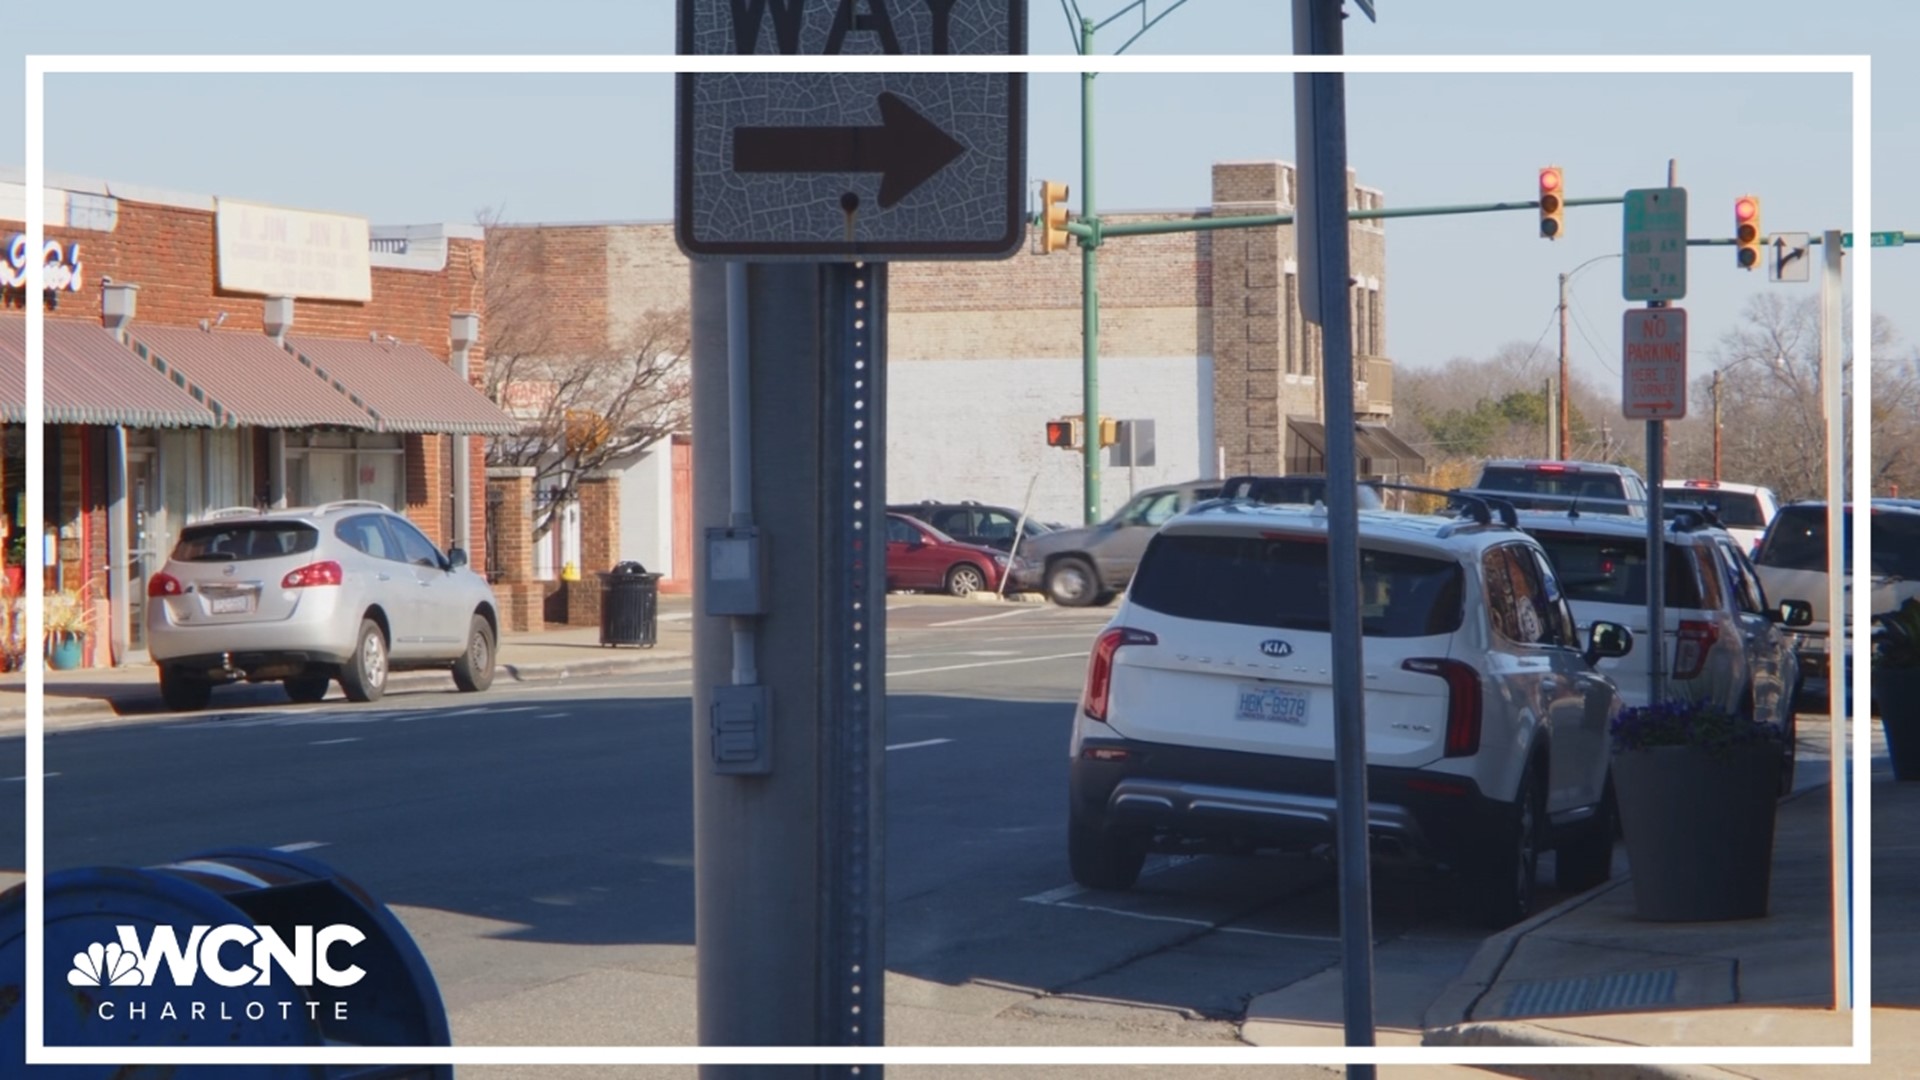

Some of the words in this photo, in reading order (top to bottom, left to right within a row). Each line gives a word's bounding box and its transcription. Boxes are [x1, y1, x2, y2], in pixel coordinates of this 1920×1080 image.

[731, 0, 958, 55] WAY
[1642, 317, 1668, 340] NO
[1627, 342, 1681, 363] PARKING
[1632, 368, 1659, 383] HERE
[1664, 367, 1678, 382] TO
[1632, 383, 1677, 398] CORNER
[1263, 641, 1289, 655] KIA
